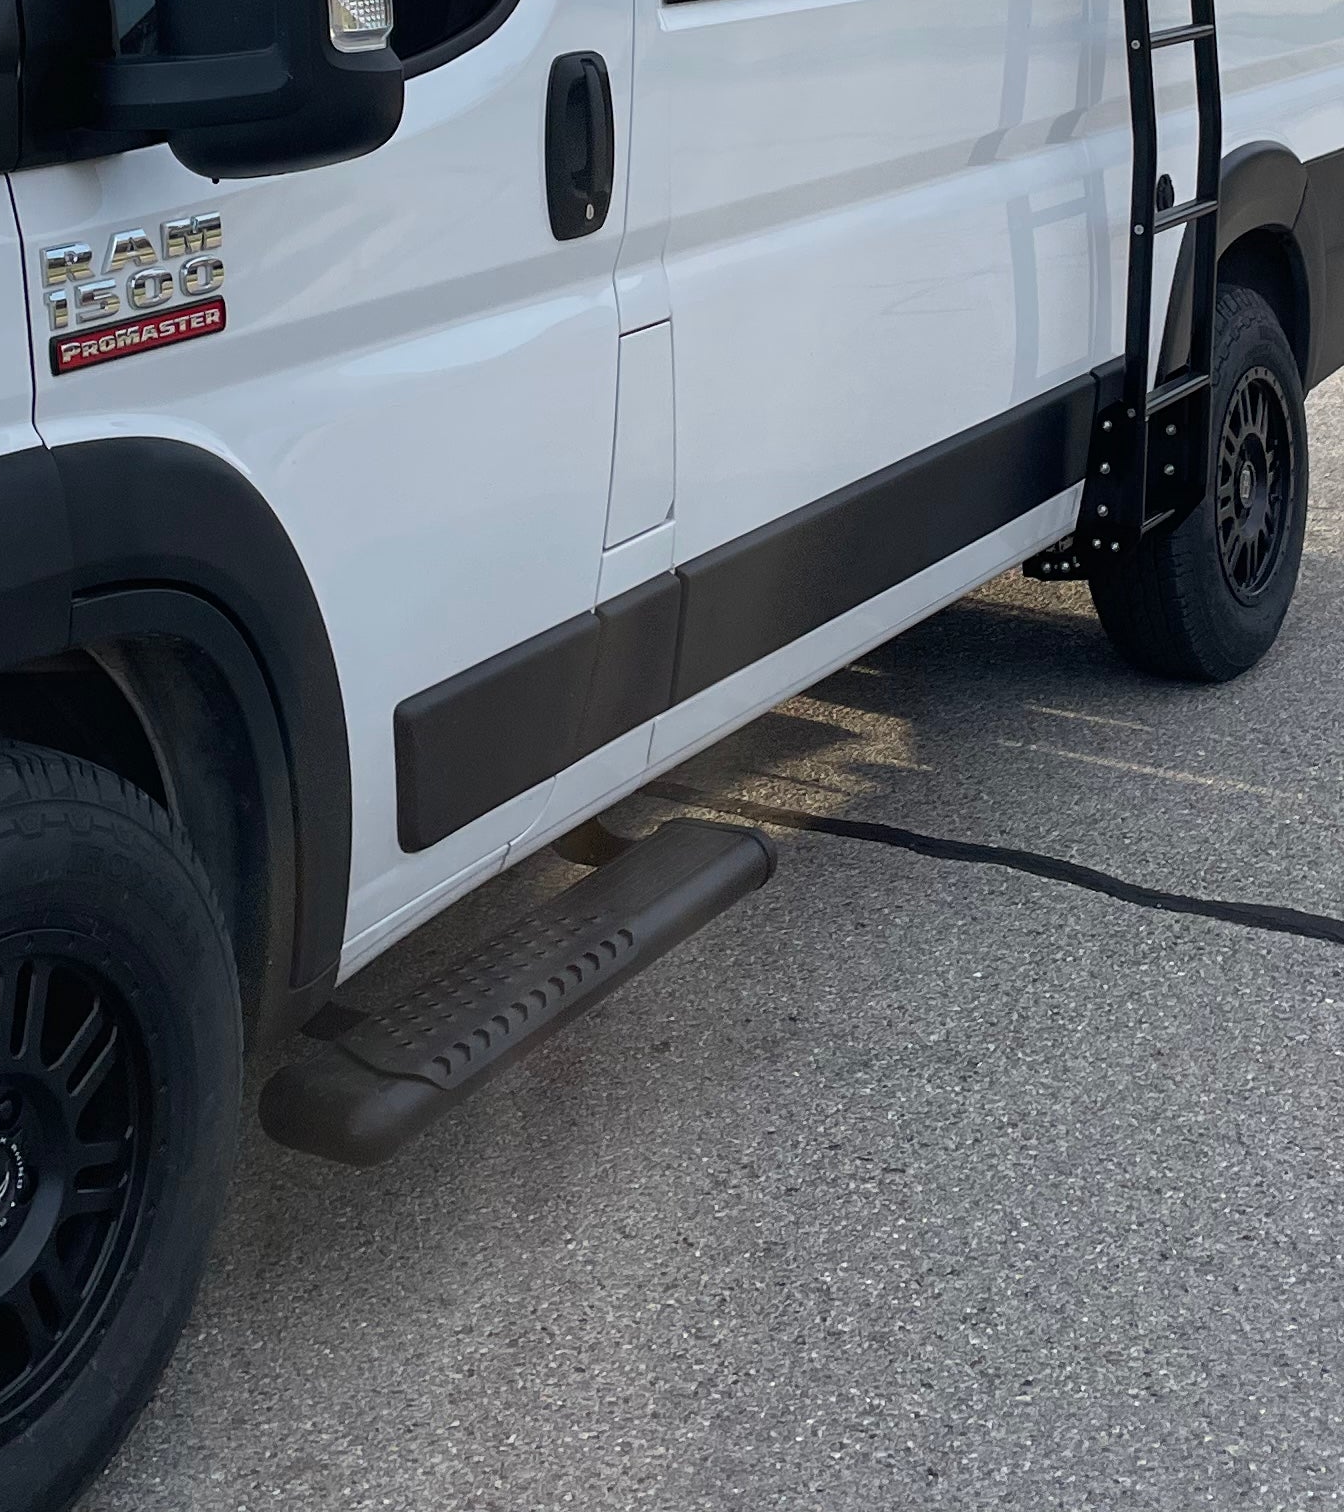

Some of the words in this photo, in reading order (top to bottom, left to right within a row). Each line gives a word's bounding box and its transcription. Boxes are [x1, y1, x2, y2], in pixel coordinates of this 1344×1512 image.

[40, 211, 222, 288] RAM
[43, 254, 224, 331] 1500
[60, 308, 220, 363] PROMASTER
